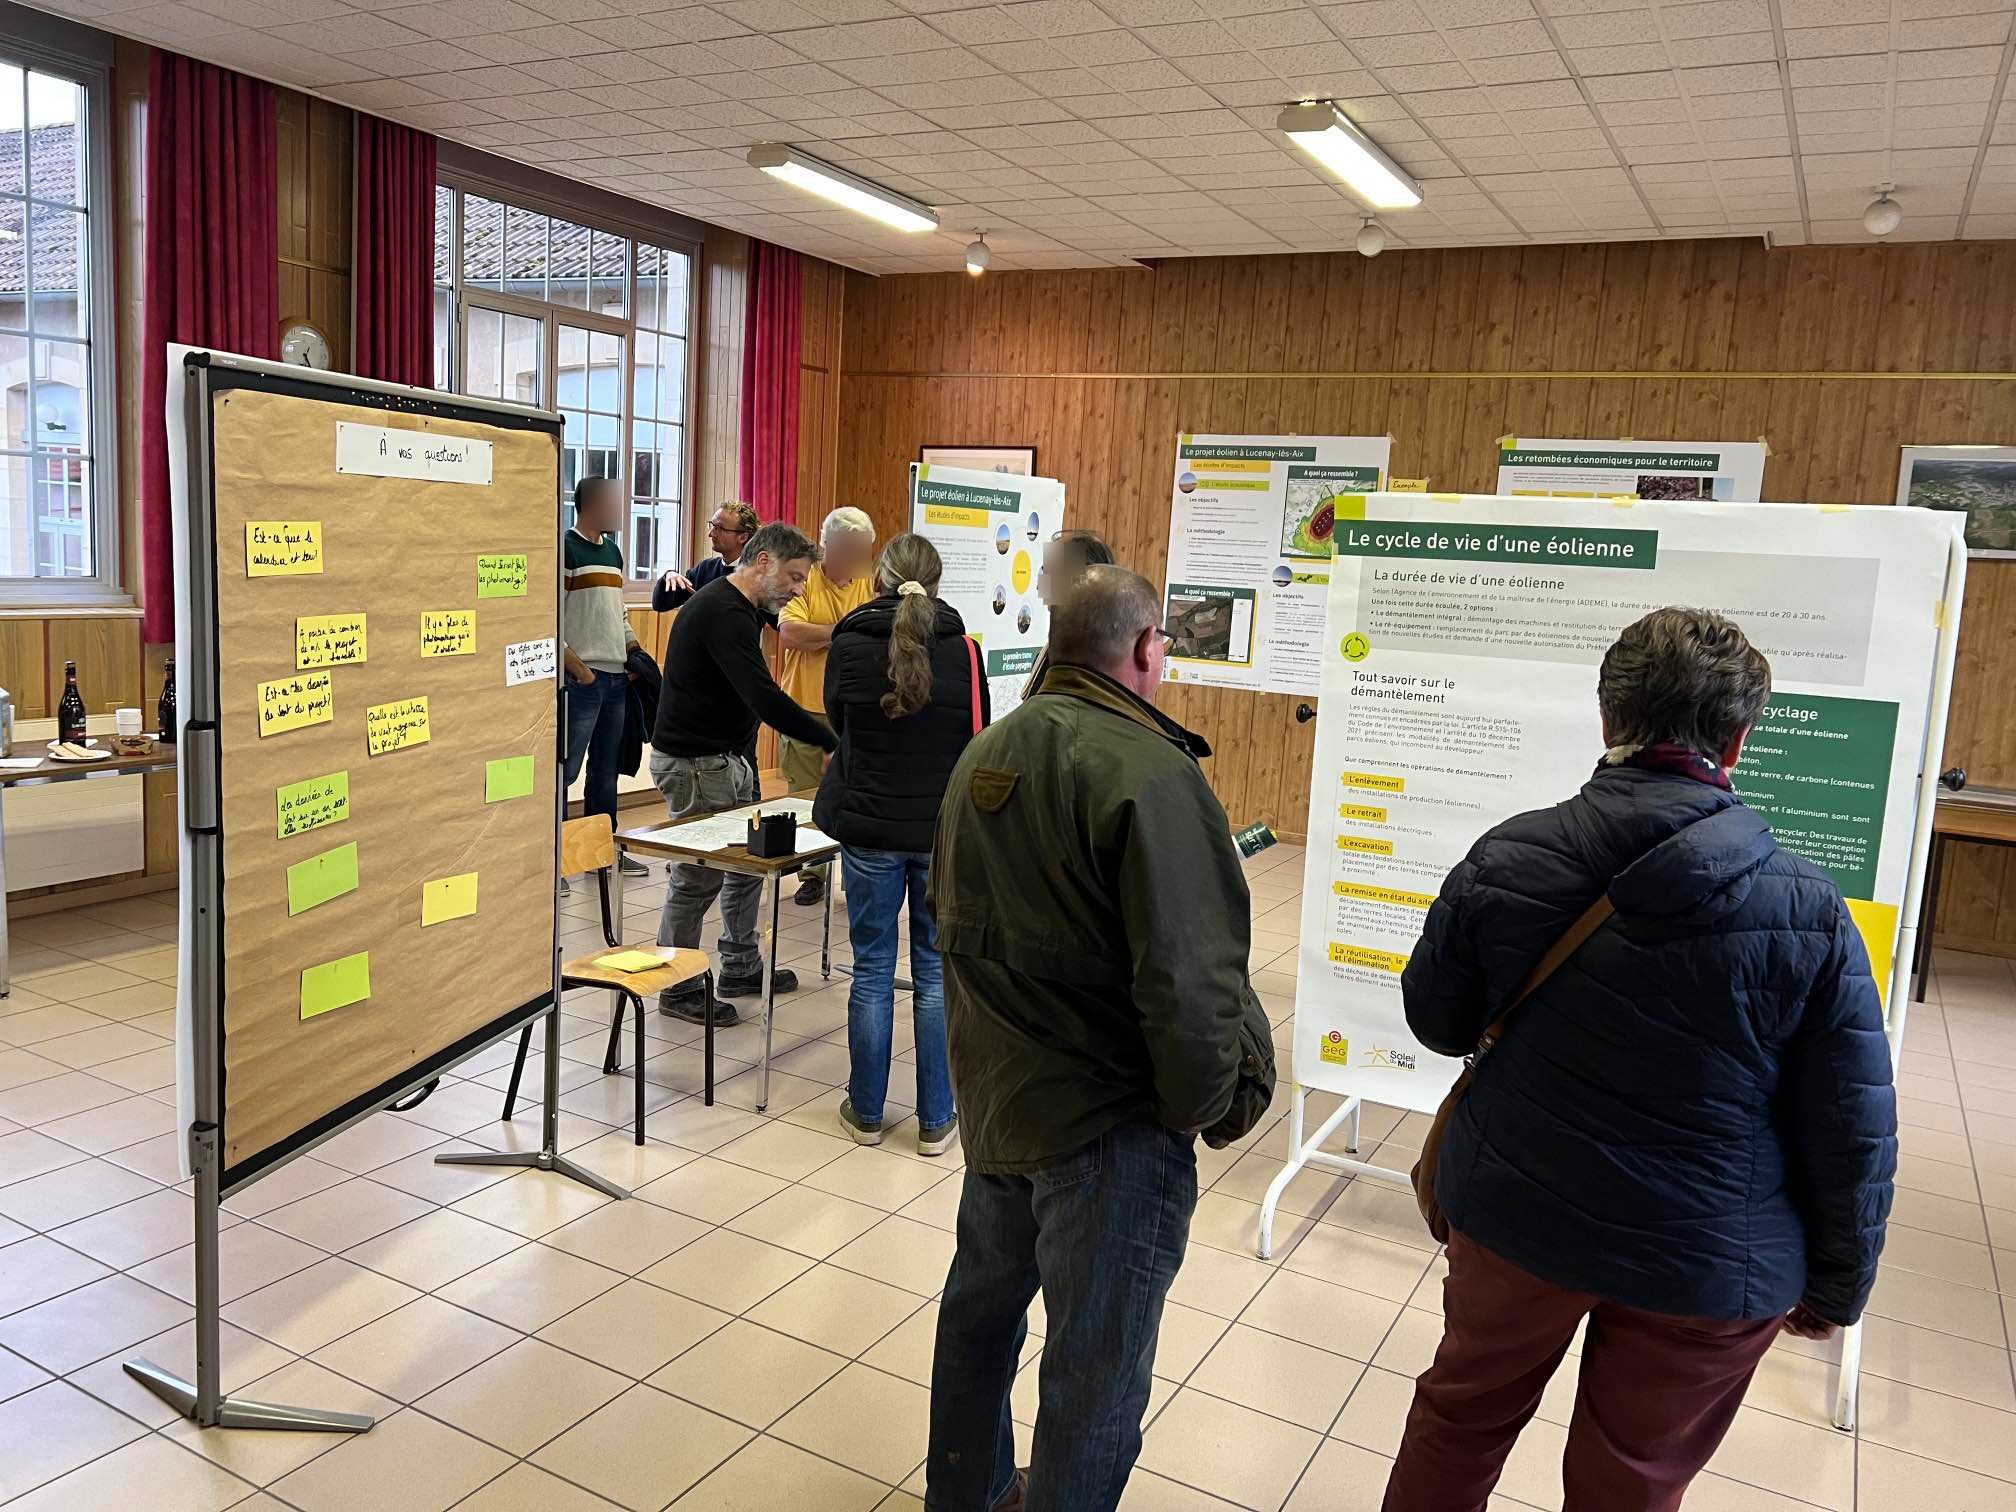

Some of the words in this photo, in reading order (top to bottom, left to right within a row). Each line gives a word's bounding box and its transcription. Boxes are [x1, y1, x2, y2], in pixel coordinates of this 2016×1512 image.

[380, 433, 387, 456] À
[398, 448, 412, 460] vos
[1194, 448, 1215, 456] projet
[1239, 448, 1244, 456] à
[1245, 449, 1303, 457] Lucenay-lès-Aix
[1525, 454, 1571, 462] retombées
[1573, 455, 1632, 465] économiques
[1634, 458, 1656, 466] pour
[1658, 456, 1667, 465] le
[1669, 458, 1712, 466] territoire
[1348, 529, 1370, 545] Le
[1375, 532, 1420, 550] cycle
[1426, 532, 1448, 548] de
[1454, 533, 1480, 550] vie
[1486, 535, 1540, 552] d'une
[1546, 536, 1634, 556] éolienne
[1374, 569, 1388, 580] La
[1392, 570, 1426, 582] durée
[1430, 572, 1444, 583] de
[1449, 573, 1466, 584] vie
[1470, 574, 1504, 586] d'une
[1508, 576, 1564, 589] éolienne
[1354, 670, 1377, 682] Tout
[1381, 675, 1416, 685] savoir
[1420, 678, 1438, 687] sur
[1444, 678, 1454, 689] le
[1350, 686, 1444, 702] démantèlement
[1762, 706, 1818, 721] cyclage
[1765, 725, 1788, 733] totale
[1789, 727, 1811, 735] d'une
[1813, 730, 1848, 739] éolienne
[1749, 745, 1782, 754] éolienne
[1349, 776, 1398, 787] L'enlèvement
[1796, 776, 1828, 784] carbone
[1781, 806, 1828, 817] l'aluminium
[1809, 830, 1824, 839] Des
[1826, 834, 1855, 842] travaux
[1344, 838, 1389, 850] L'excavation
[1805, 839, 1821, 847] leur
[1822, 843, 1866, 852] conception
[1826, 851, 1840, 859] des
[1842, 853, 1864, 862] pâles
[1828, 860, 1847, 868] pour
[1351, 888, 1377, 897] remise
[1390, 892, 1404, 901] état
[1335, 946, 1344, 954] La
[1346, 949, 1393, 964] réutilisation,
[1344, 955, 1389, 970] l'élimination
[1390, 1050, 1416, 1063] Soleil
[1397, 1061, 1415, 1070] Midi
